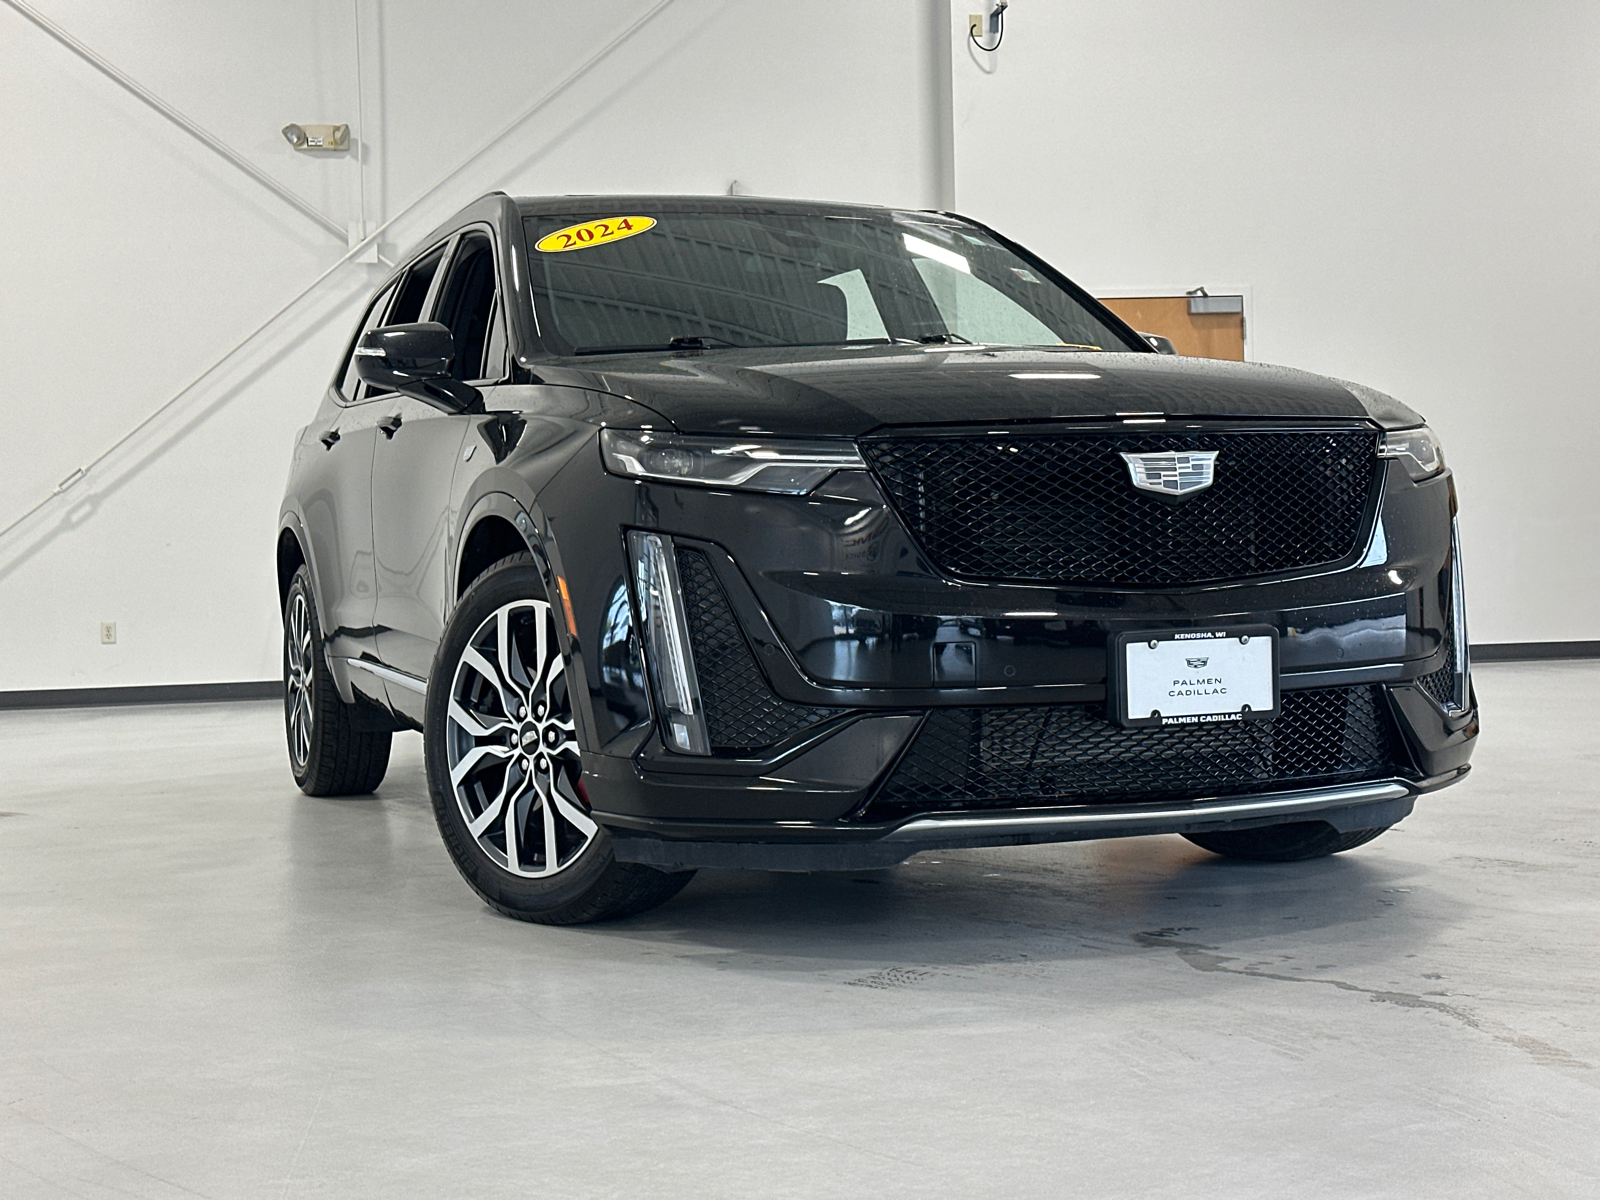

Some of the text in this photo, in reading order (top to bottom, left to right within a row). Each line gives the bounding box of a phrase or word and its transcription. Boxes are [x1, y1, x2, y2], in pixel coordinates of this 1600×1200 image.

[557, 219, 633, 248] 2024
[1174, 632, 1214, 640] KENOSHA,
[1173, 678, 1222, 686] PALMEN
[1168, 687, 1227, 697] CADILLAC
[1162, 713, 1242, 725] PALMEN CADILLAC
